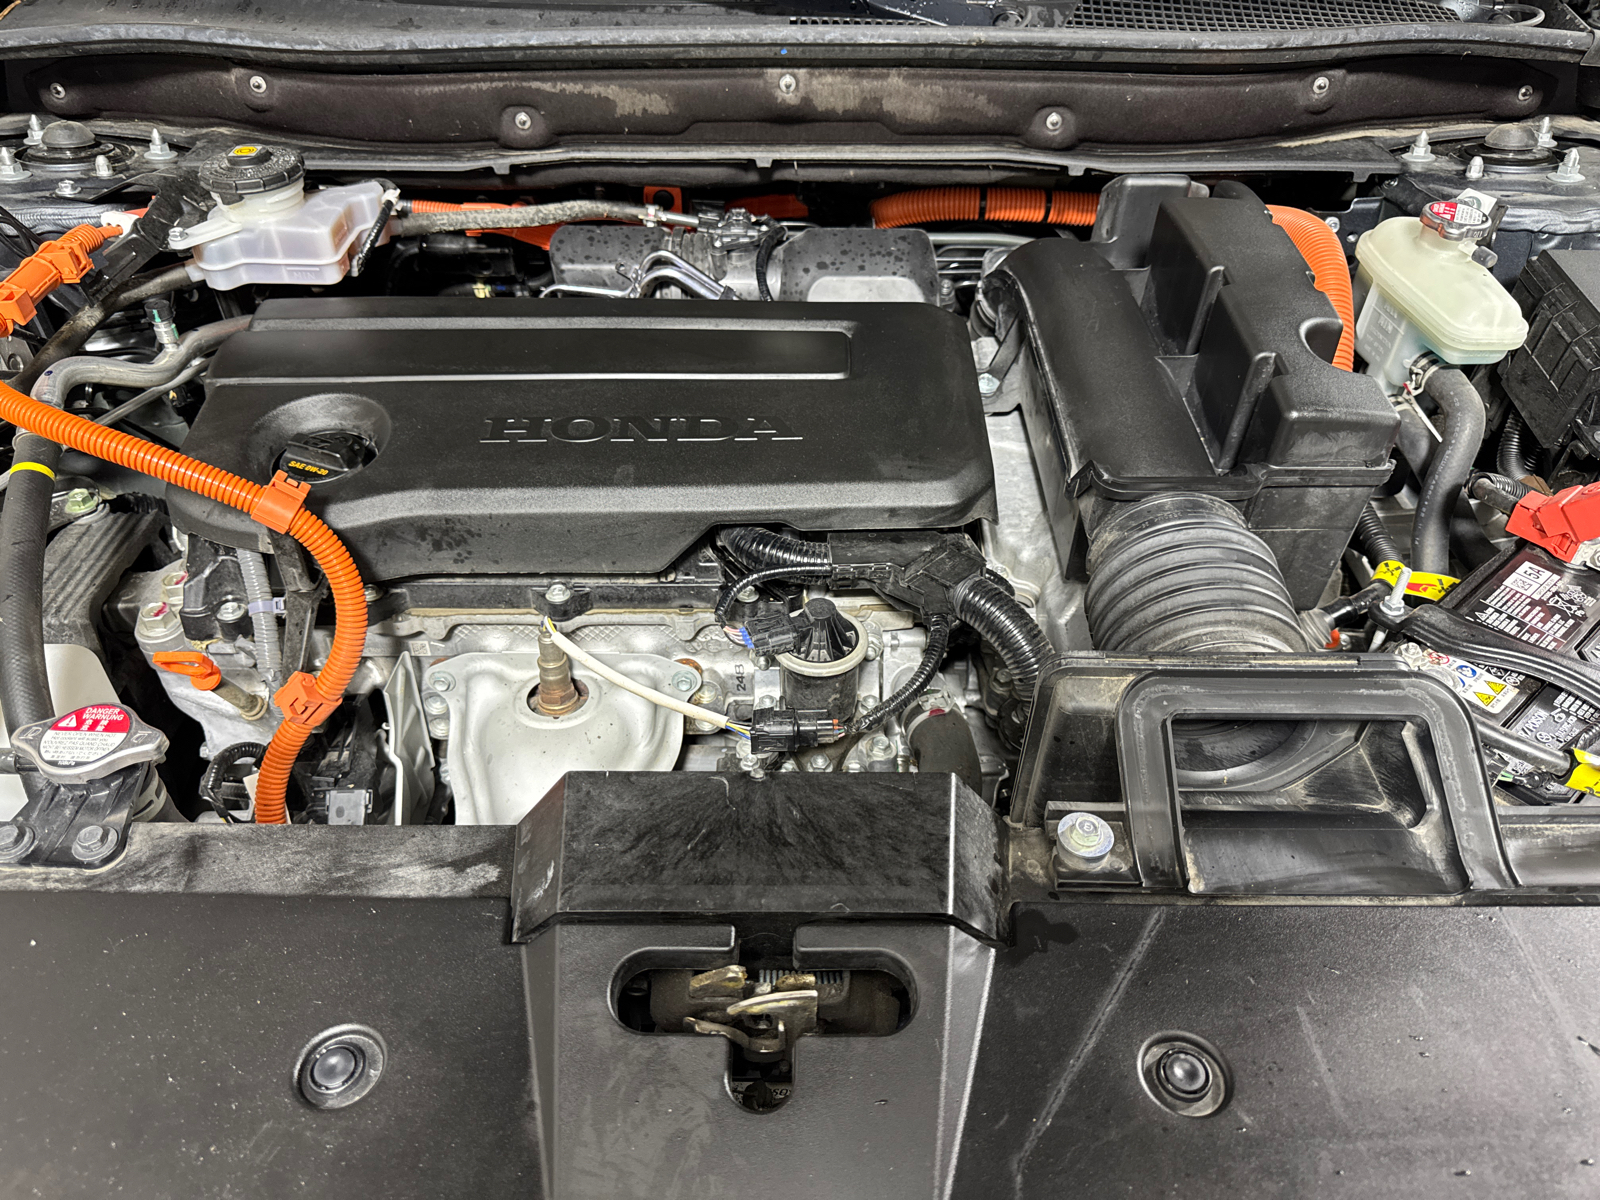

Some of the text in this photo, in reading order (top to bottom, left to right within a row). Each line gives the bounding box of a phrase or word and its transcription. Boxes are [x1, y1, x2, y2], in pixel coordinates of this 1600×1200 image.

[479, 416, 803, 443] HONDA
[288, 460, 307, 470] SAE
[1523, 566, 1546, 580] 5A
[85, 707, 121, 715] DANGER
[82, 713, 125, 721] WARNUNG
